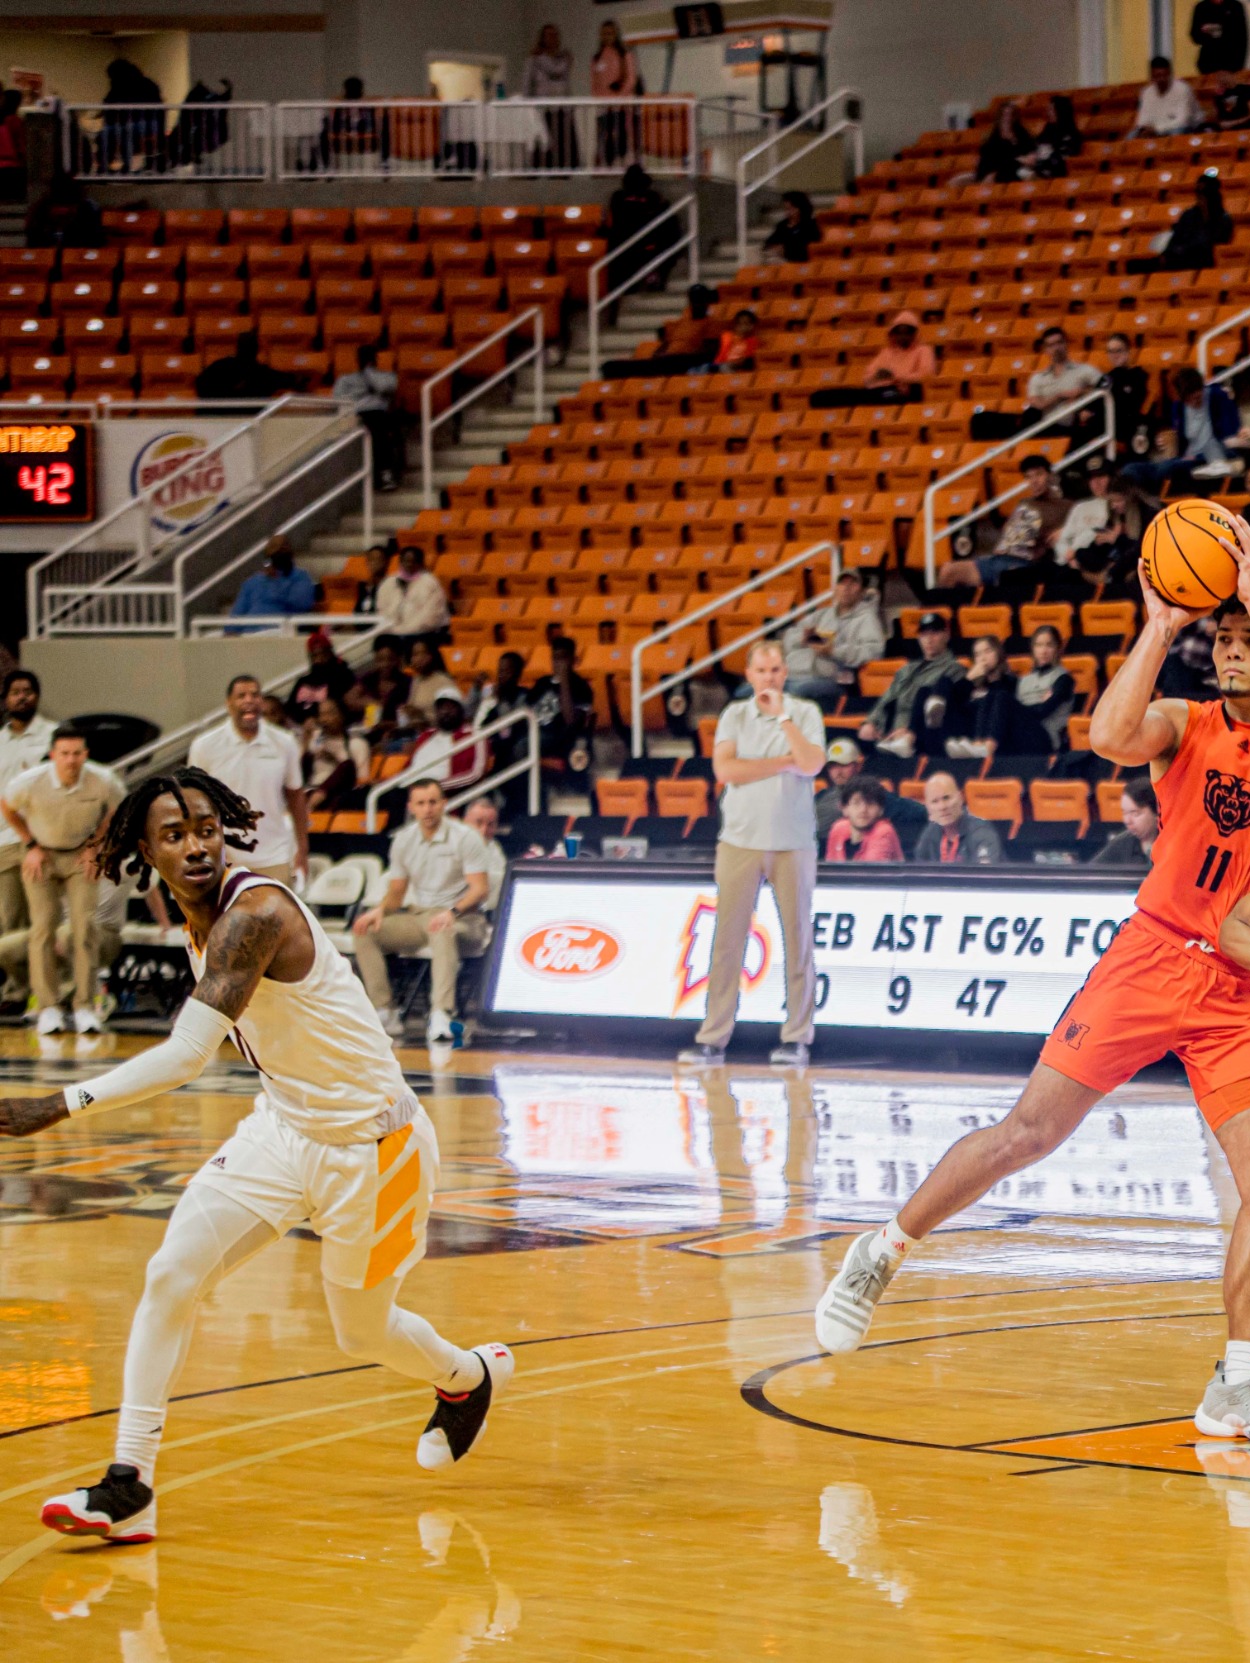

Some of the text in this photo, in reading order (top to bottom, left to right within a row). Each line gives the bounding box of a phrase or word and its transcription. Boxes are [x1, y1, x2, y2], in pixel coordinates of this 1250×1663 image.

[18, 462, 75, 505] 42
[1195, 845, 1233, 893] 11
[533, 926, 602, 973] Ford
[812, 912, 1117, 958] EB AST FG% FO
[886, 975, 911, 1016] 9
[956, 977, 1007, 1017] 47
